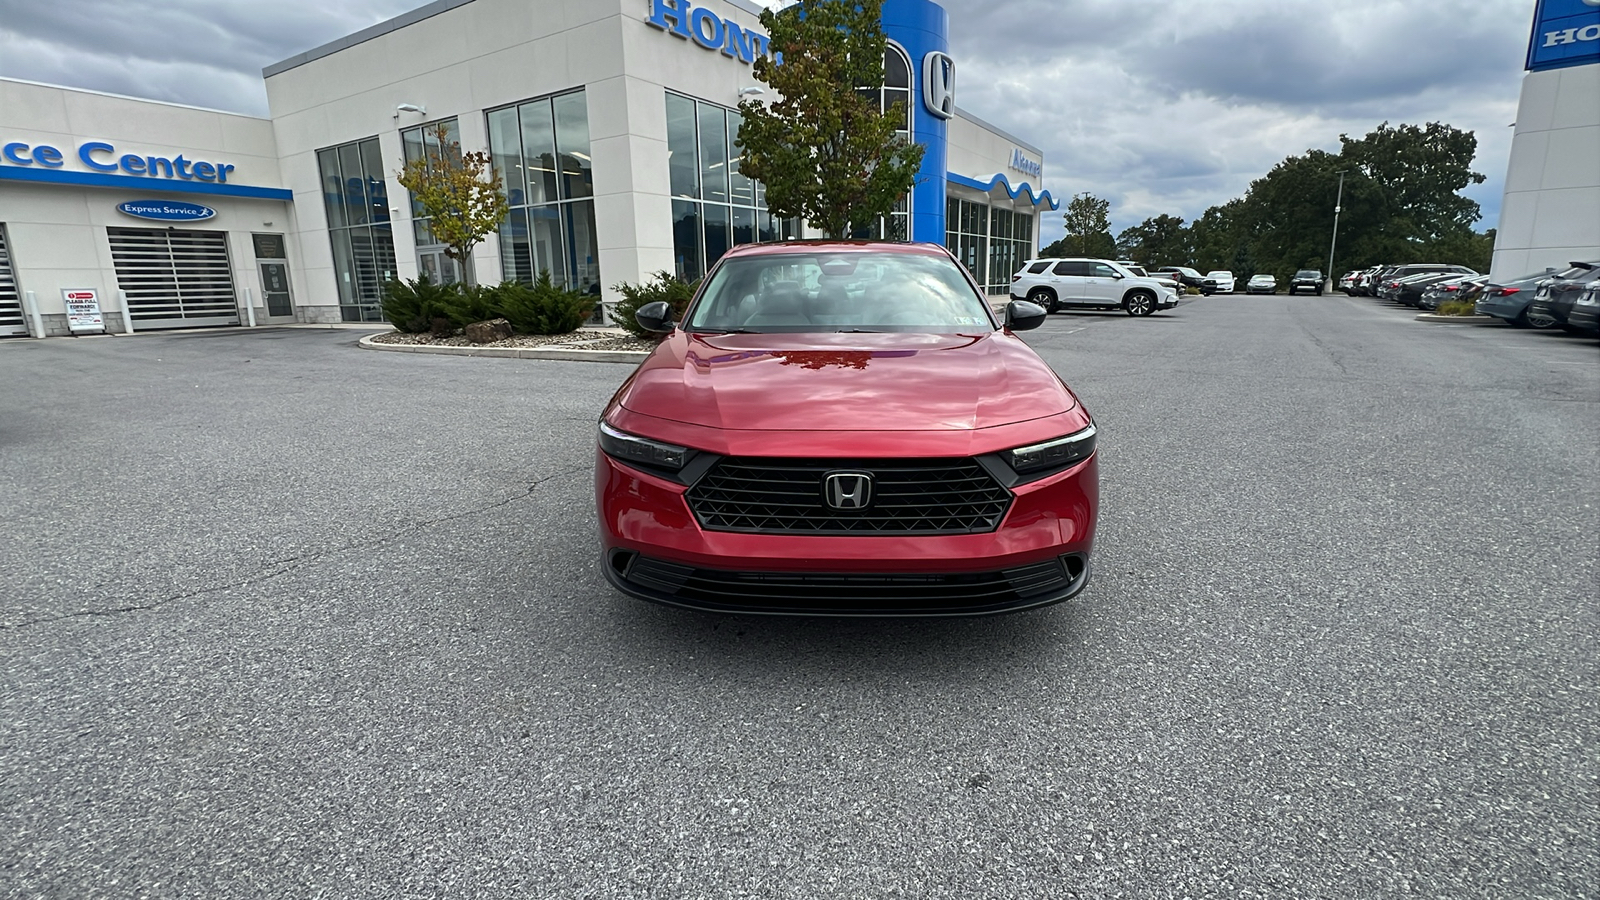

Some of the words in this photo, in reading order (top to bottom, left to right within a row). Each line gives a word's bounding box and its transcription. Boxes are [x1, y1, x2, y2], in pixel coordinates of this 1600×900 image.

[1542, 24, 1600, 48] HO
[0, 142, 64, 168] ce
[78, 142, 235, 183] Center
[124, 204, 162, 214] Express
[163, 206, 197, 215] Service
